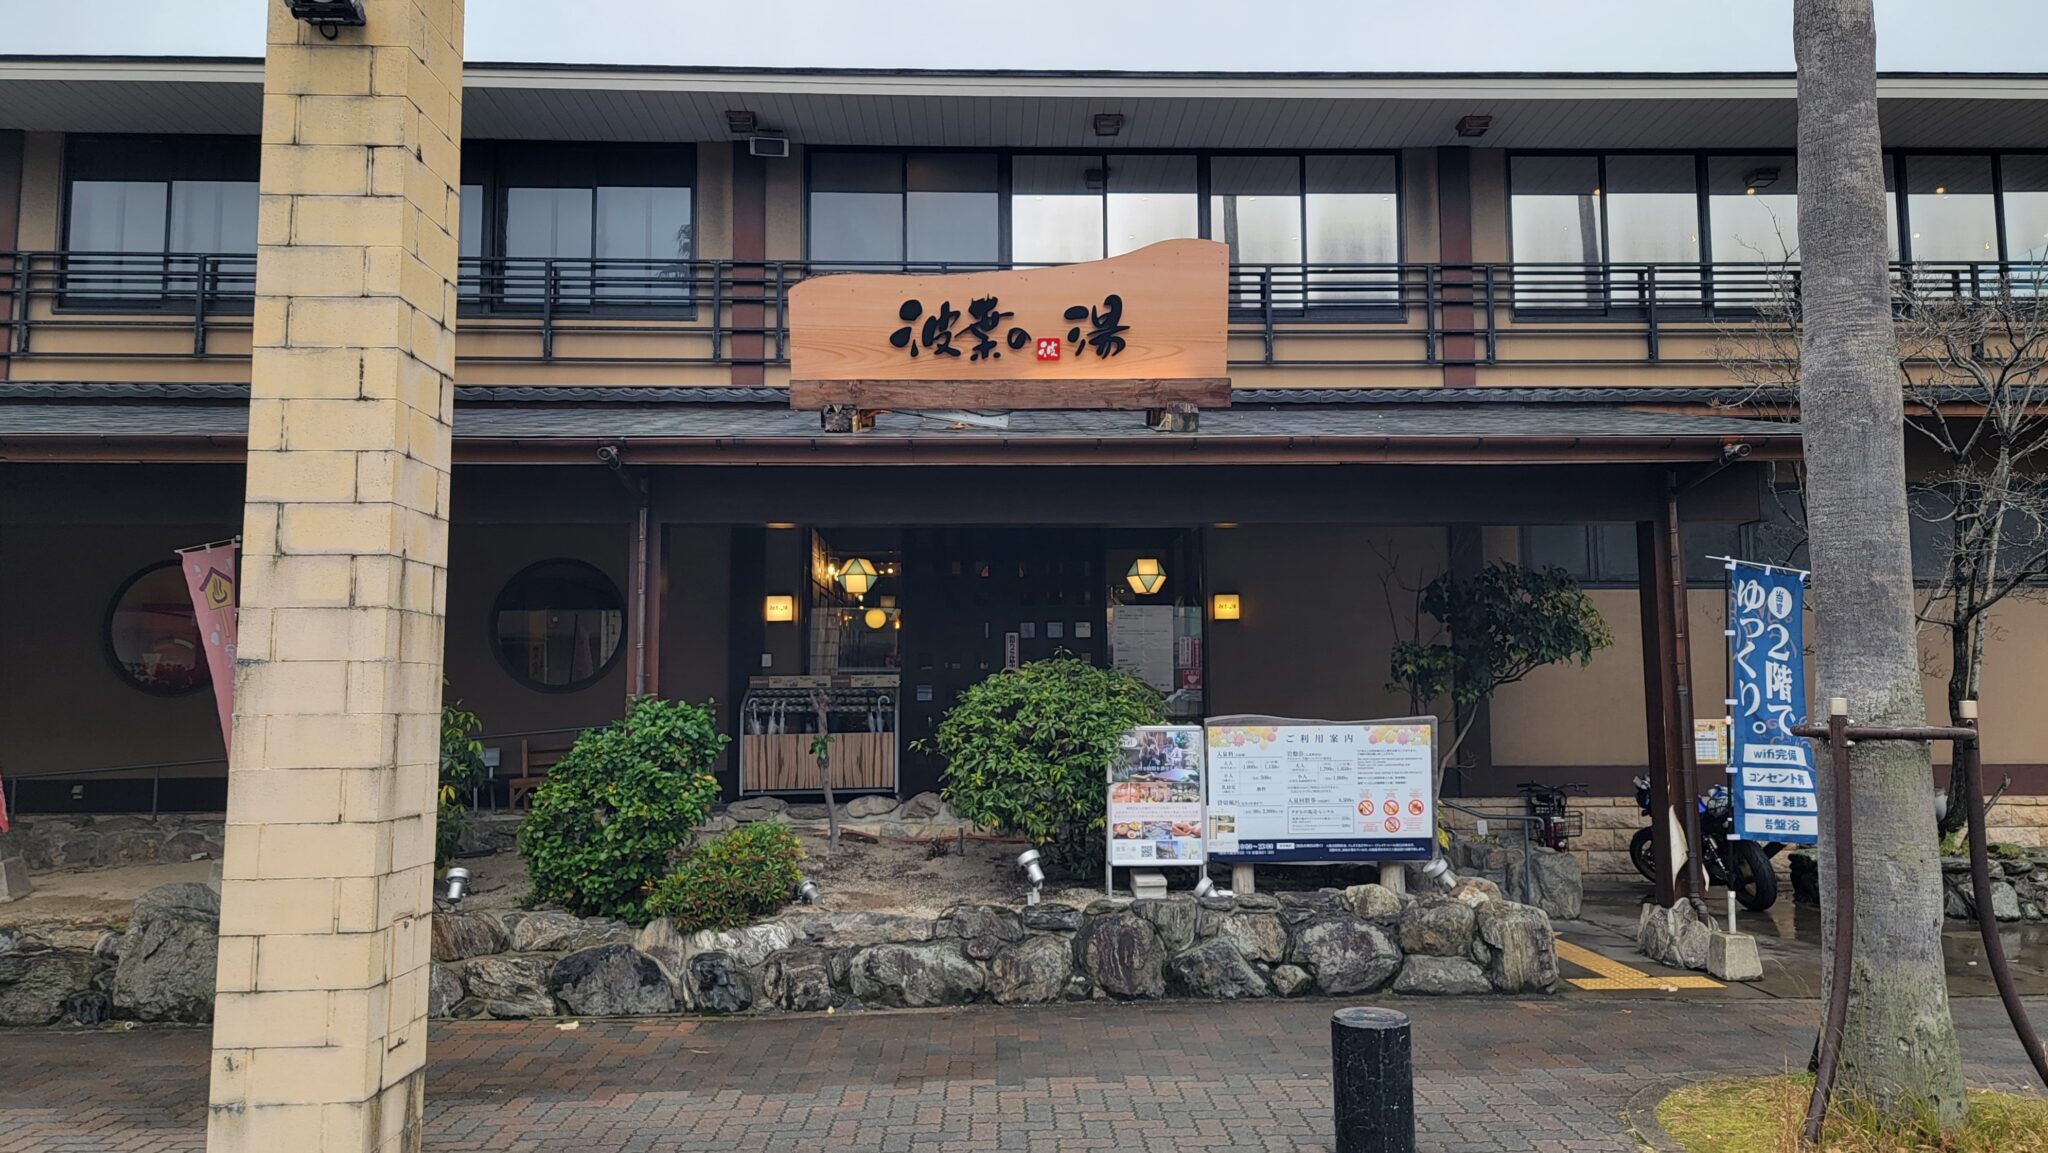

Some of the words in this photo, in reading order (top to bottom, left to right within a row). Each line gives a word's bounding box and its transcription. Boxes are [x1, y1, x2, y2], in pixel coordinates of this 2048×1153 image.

[890, 293, 1130, 361] 波葉の湯
[1737, 579, 1767, 734] ゆっくり。
[1286, 733, 1353, 743] ご利用案内
[1753, 748, 1797, 761] wifi完備
[1749, 772, 1805, 786] コンセント有
[1756, 794, 1807, 808] 漫画・雑誌
[1765, 818, 1800, 831] 岩盤浴
